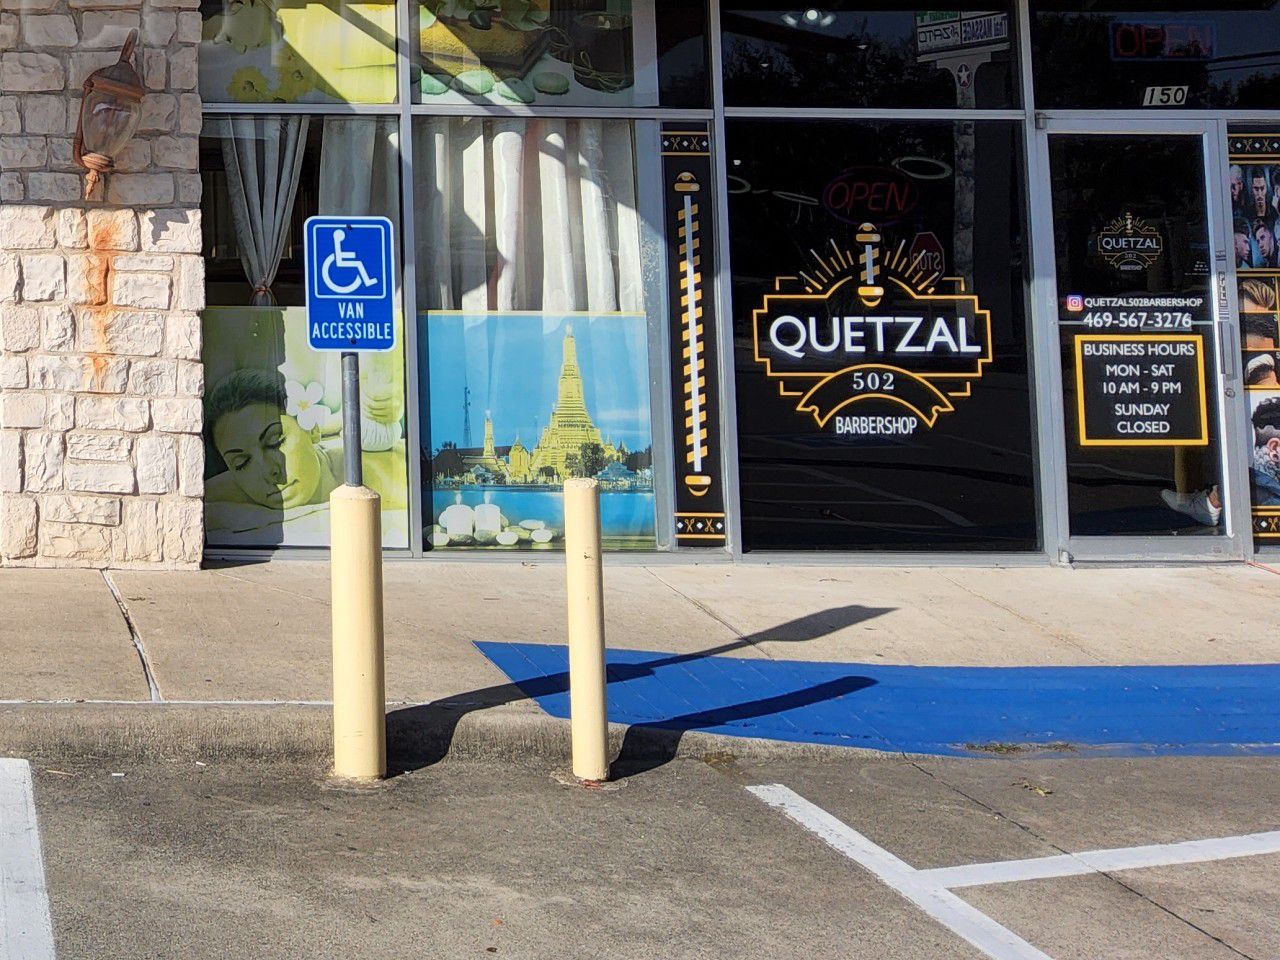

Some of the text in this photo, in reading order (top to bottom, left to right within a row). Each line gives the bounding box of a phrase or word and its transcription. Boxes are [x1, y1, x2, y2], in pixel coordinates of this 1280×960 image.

[1115, 24, 1213, 57] OPEN
[1147, 87, 1187, 105] 150
[828, 182, 911, 211] OPEN
[1101, 237, 1159, 250] QUETZAL
[337, 301, 365, 319] VAN
[1083, 312, 1192, 328] 469-567-3276
[311, 322, 392, 340] ACCESSIBLE
[769, 315, 982, 359] QUETZAL
[1083, 343, 1195, 356] BUSINESS HOURS
[1105, 364, 1140, 377] MON
[1151, 364, 1175, 377] SAT
[852, 372, 895, 391] 502
[1102, 381, 1116, 394] 10
[1118, 381, 1140, 394] AM
[1150, 381, 1159, 394] 9
[1161, 381, 1182, 394] PM
[1114, 403, 1171, 416] SUNDAY
[835, 416, 918, 435] BARBERSHOP
[1116, 421, 1171, 434] CLOSED
